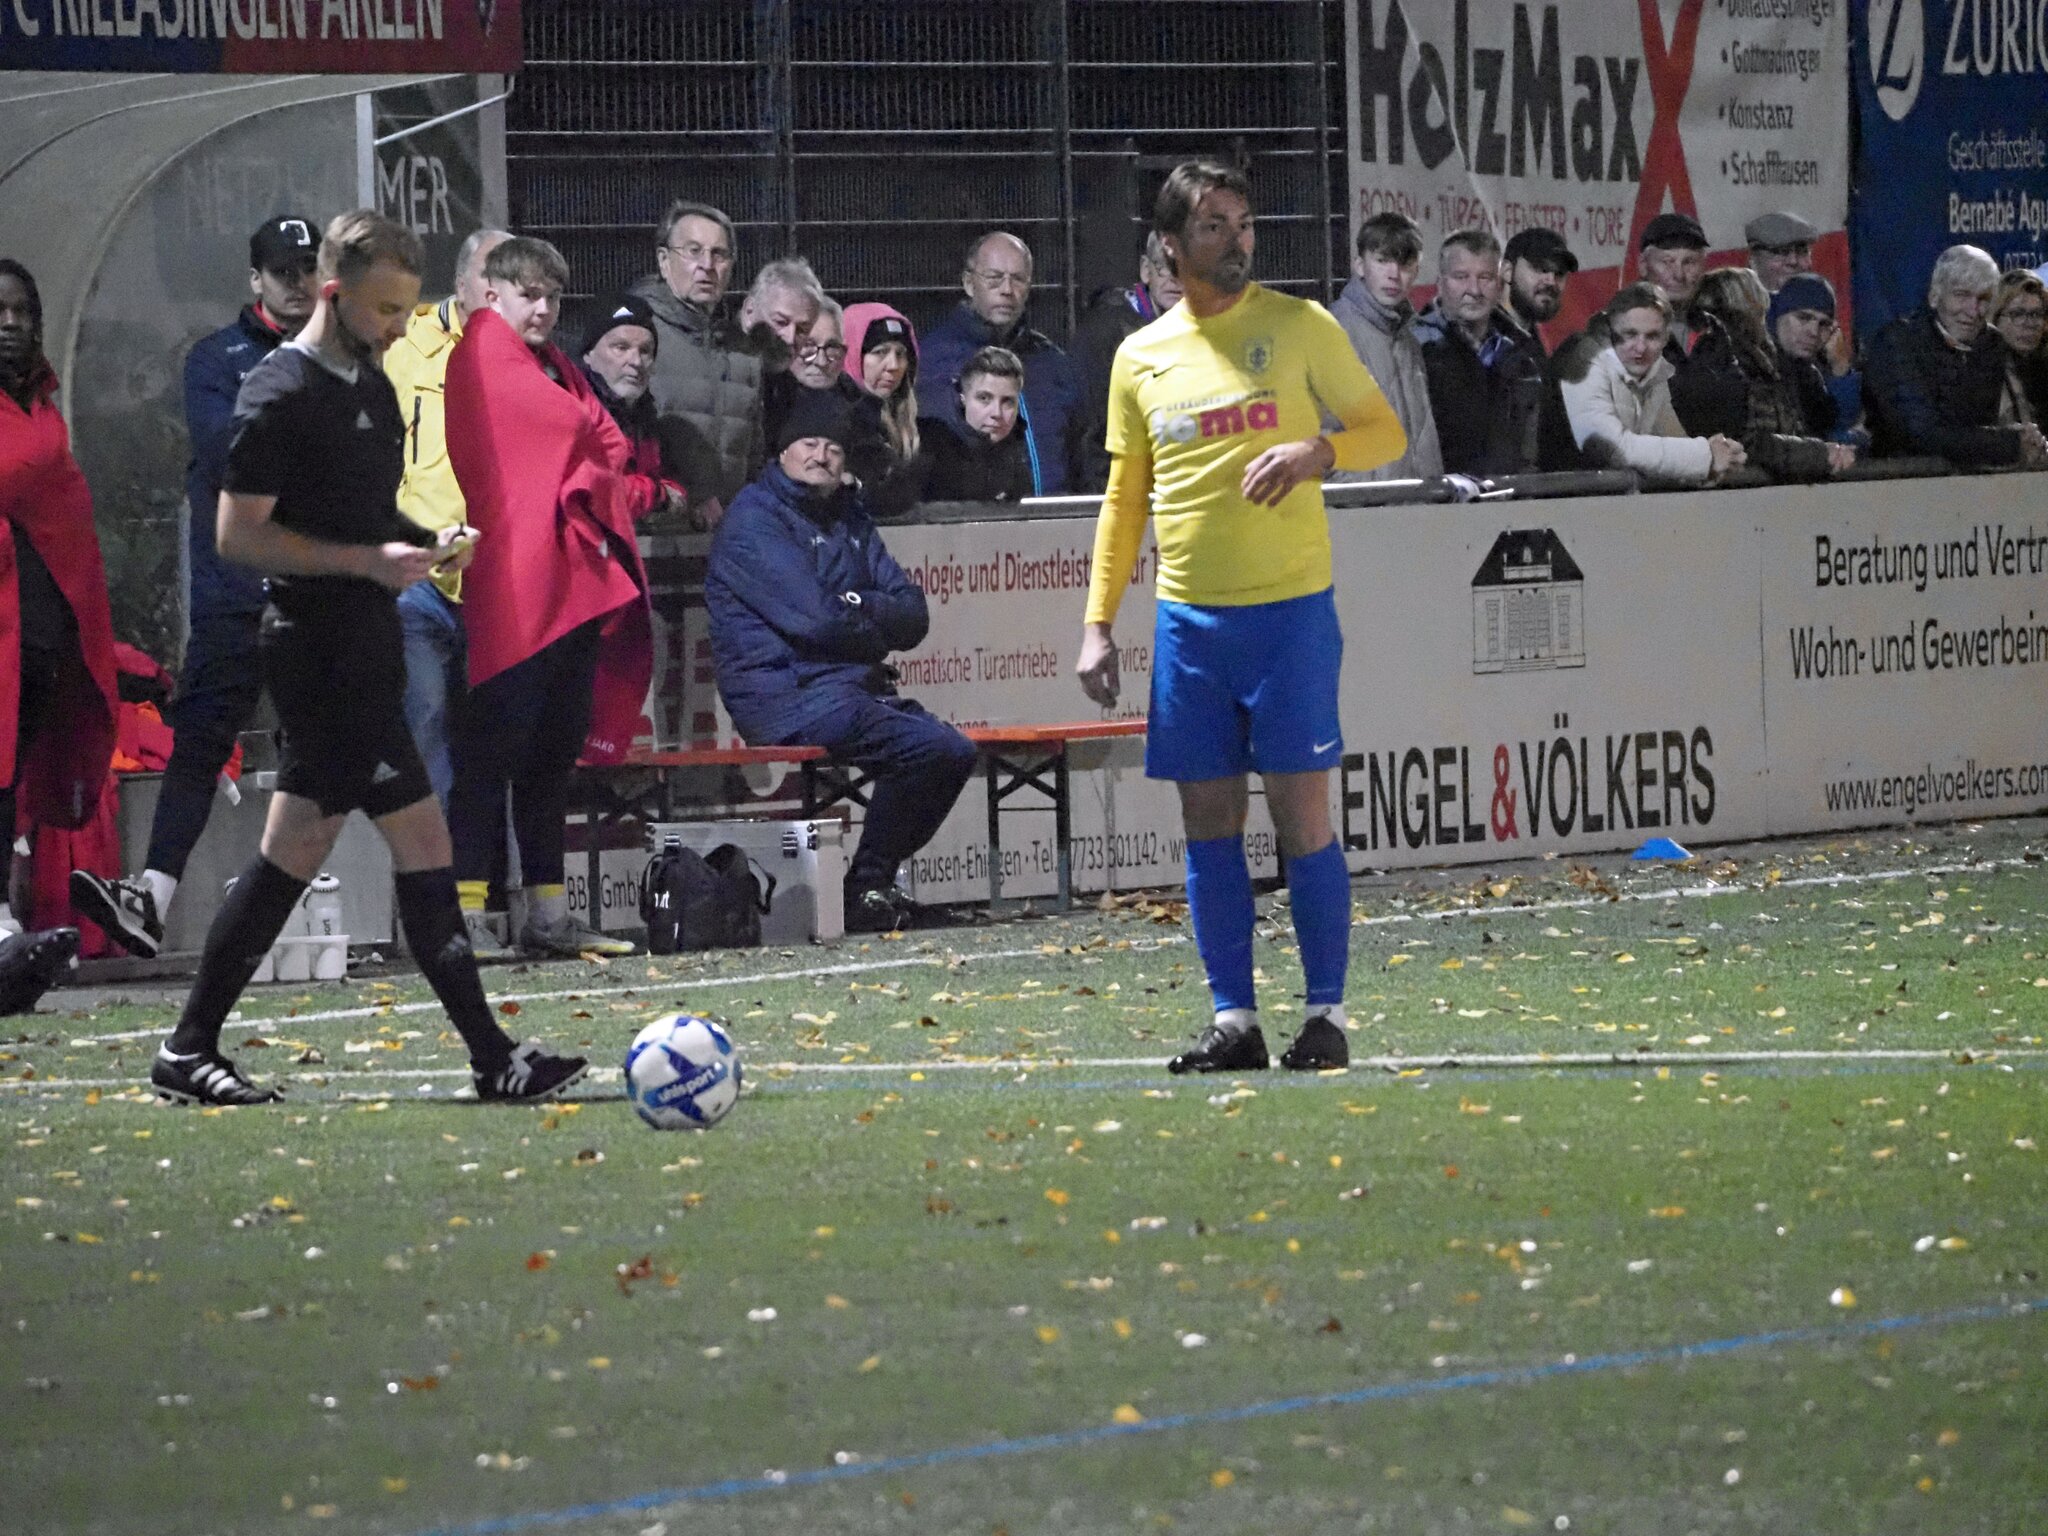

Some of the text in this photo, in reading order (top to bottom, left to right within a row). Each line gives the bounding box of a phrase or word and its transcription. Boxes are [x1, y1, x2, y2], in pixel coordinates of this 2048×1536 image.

[1728, 97, 1794, 131] Konstanz
[1731, 150, 1820, 186] Schaffhausen
[1949, 128, 2046, 173] Geschäftsstelle
[1587, 206, 1625, 246] TORE
[1949, 189, 2016, 234] Bernabé
[969, 552, 1000, 592] und
[1005, 548, 1092, 591] Dienstleist
[1815, 533, 1927, 592] Beratung
[1934, 526, 1978, 579] und
[892, 643, 1058, 687] tomatische Türantriebe
[1790, 625, 1865, 679] Wohn-
[1871, 620, 1915, 674] und
[1070, 836, 1104, 871] 7733
